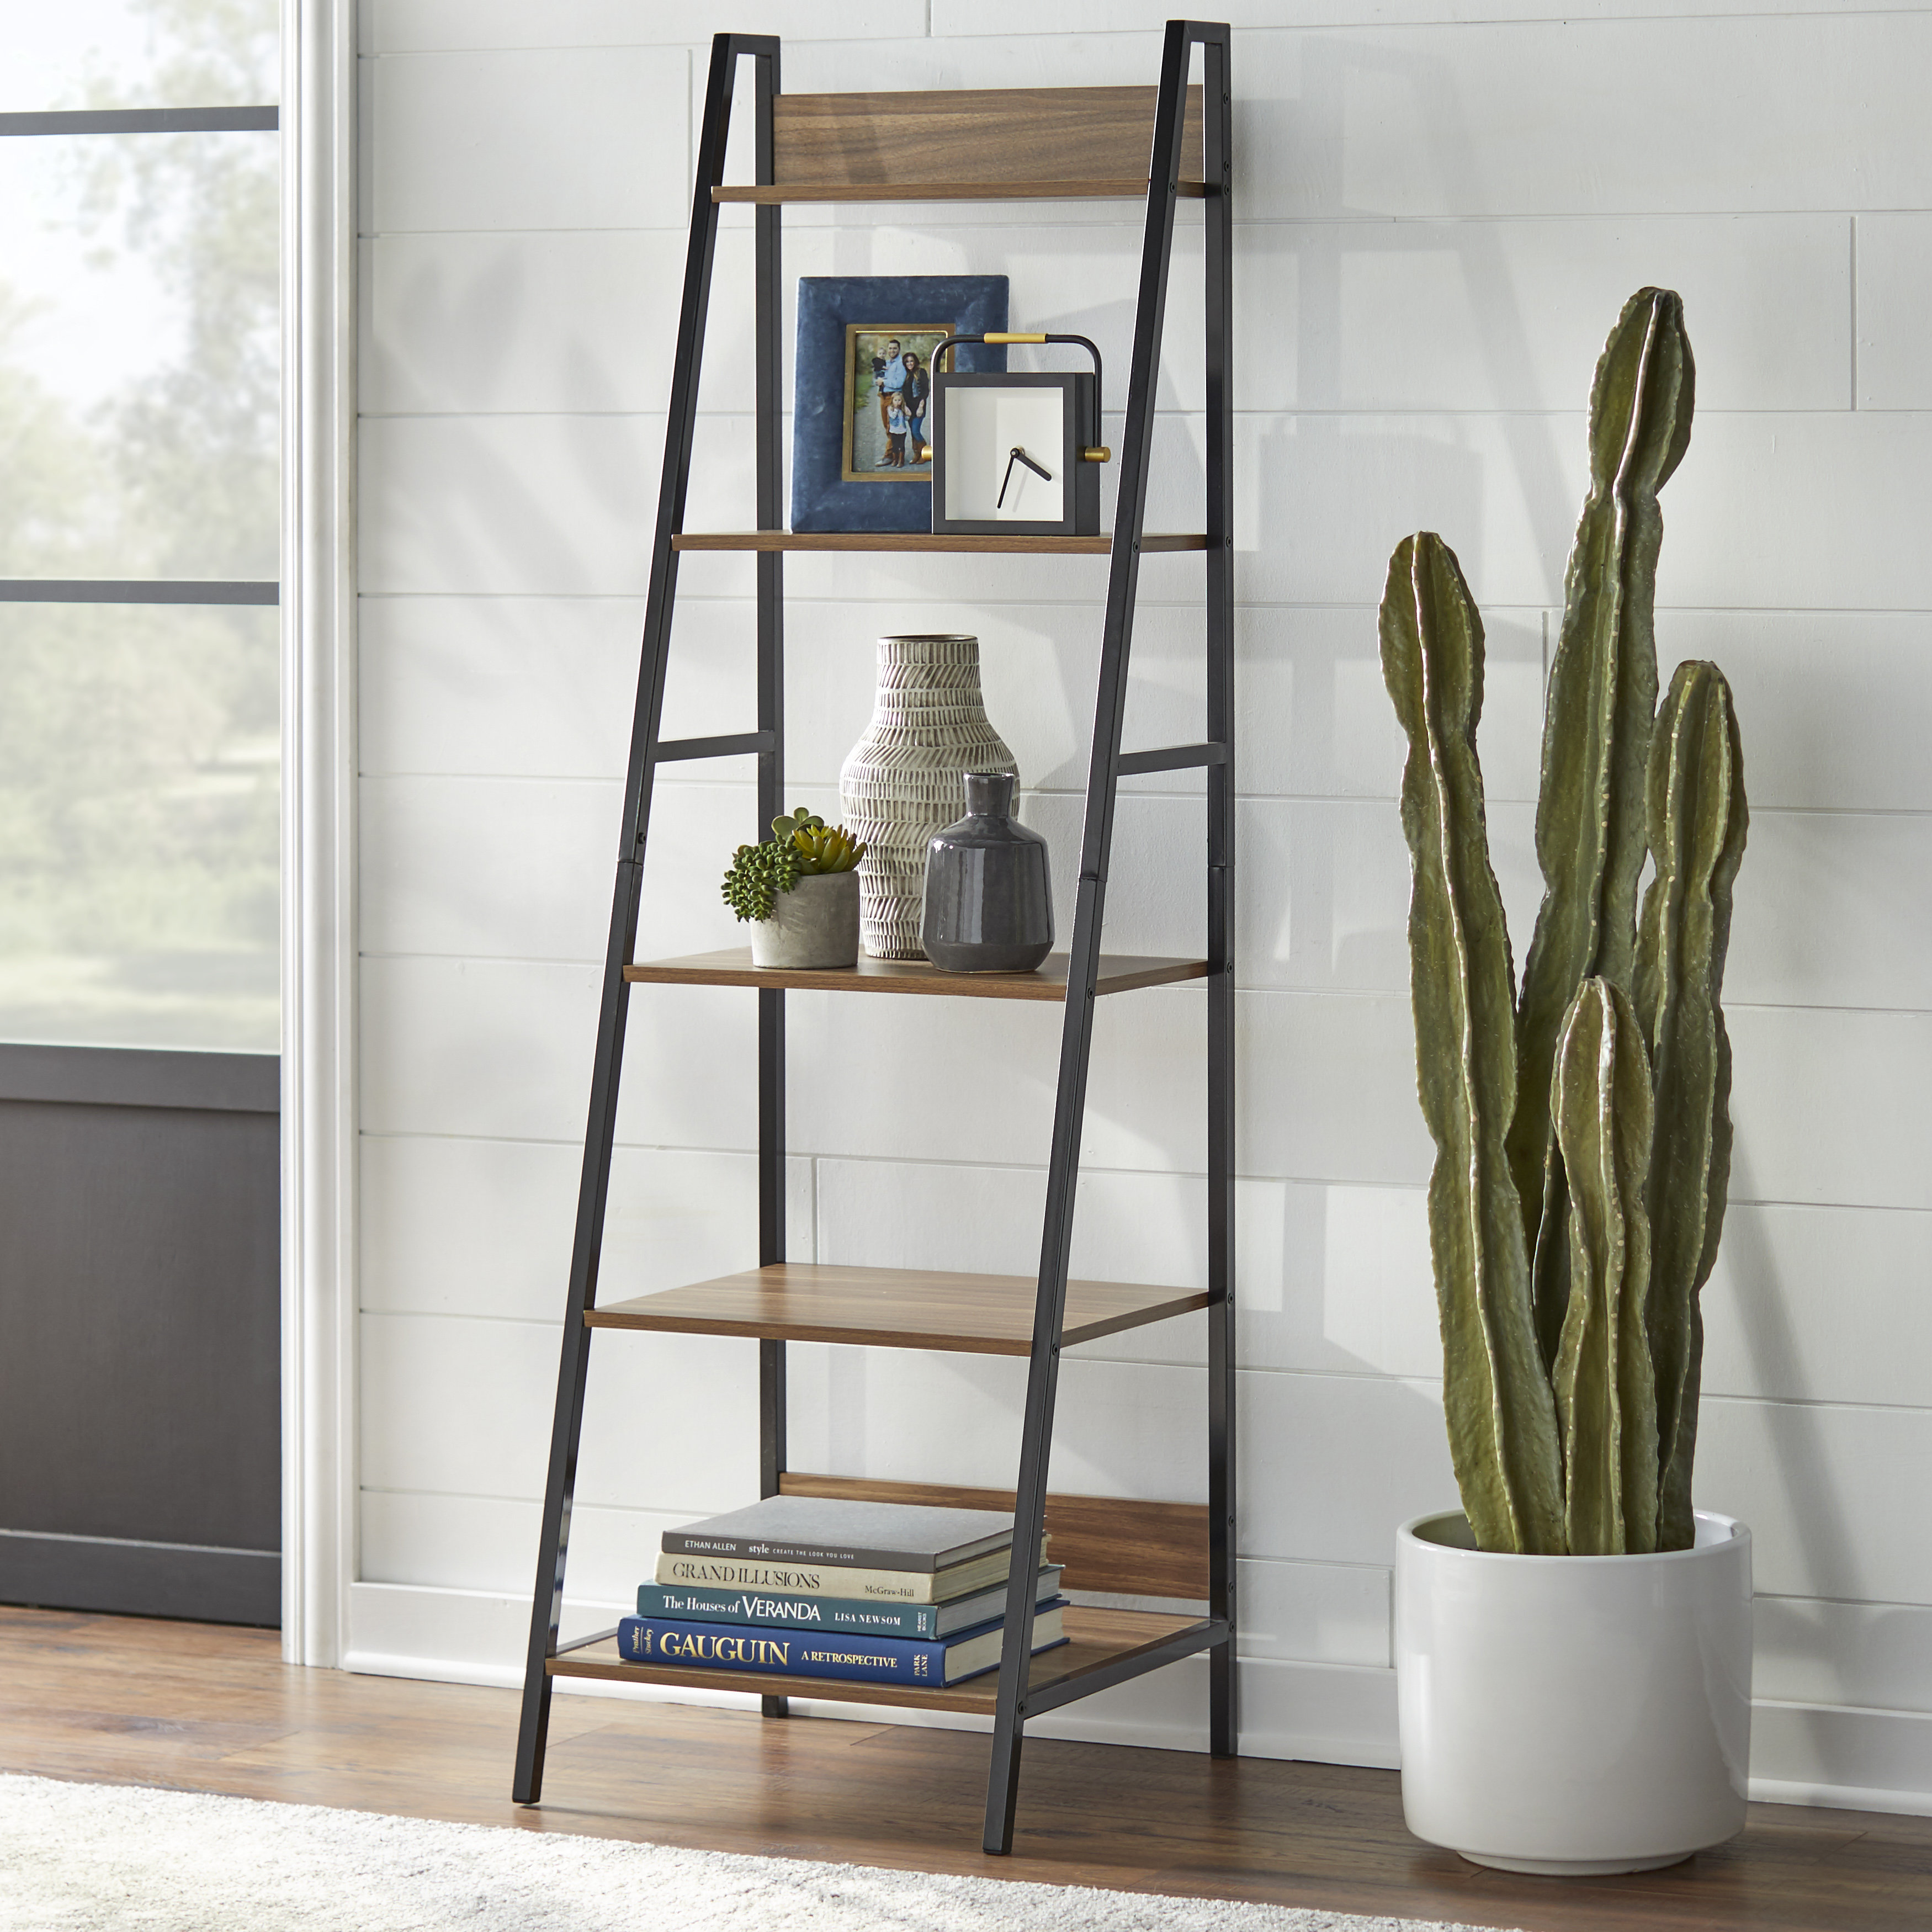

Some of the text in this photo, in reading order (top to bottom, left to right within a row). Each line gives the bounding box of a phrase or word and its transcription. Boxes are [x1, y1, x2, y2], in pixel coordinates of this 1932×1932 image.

[684, 1540, 711, 1549] ETHAN
[712, 1542, 736, 1551] ALLEN
[749, 1543, 769, 1555] style
[673, 1562, 820, 1589] GRAND ILLUSIONS
[865, 1585, 914, 1596] McGraw-Hill
[663, 1595, 821, 1621] The Houses of VERANDA
[835, 1612, 901, 1626] LISA NEWSOM
[660, 1632, 790, 1666] GAUGUIN
[802, 1650, 897, 1668] A RETROSPECTIVE
